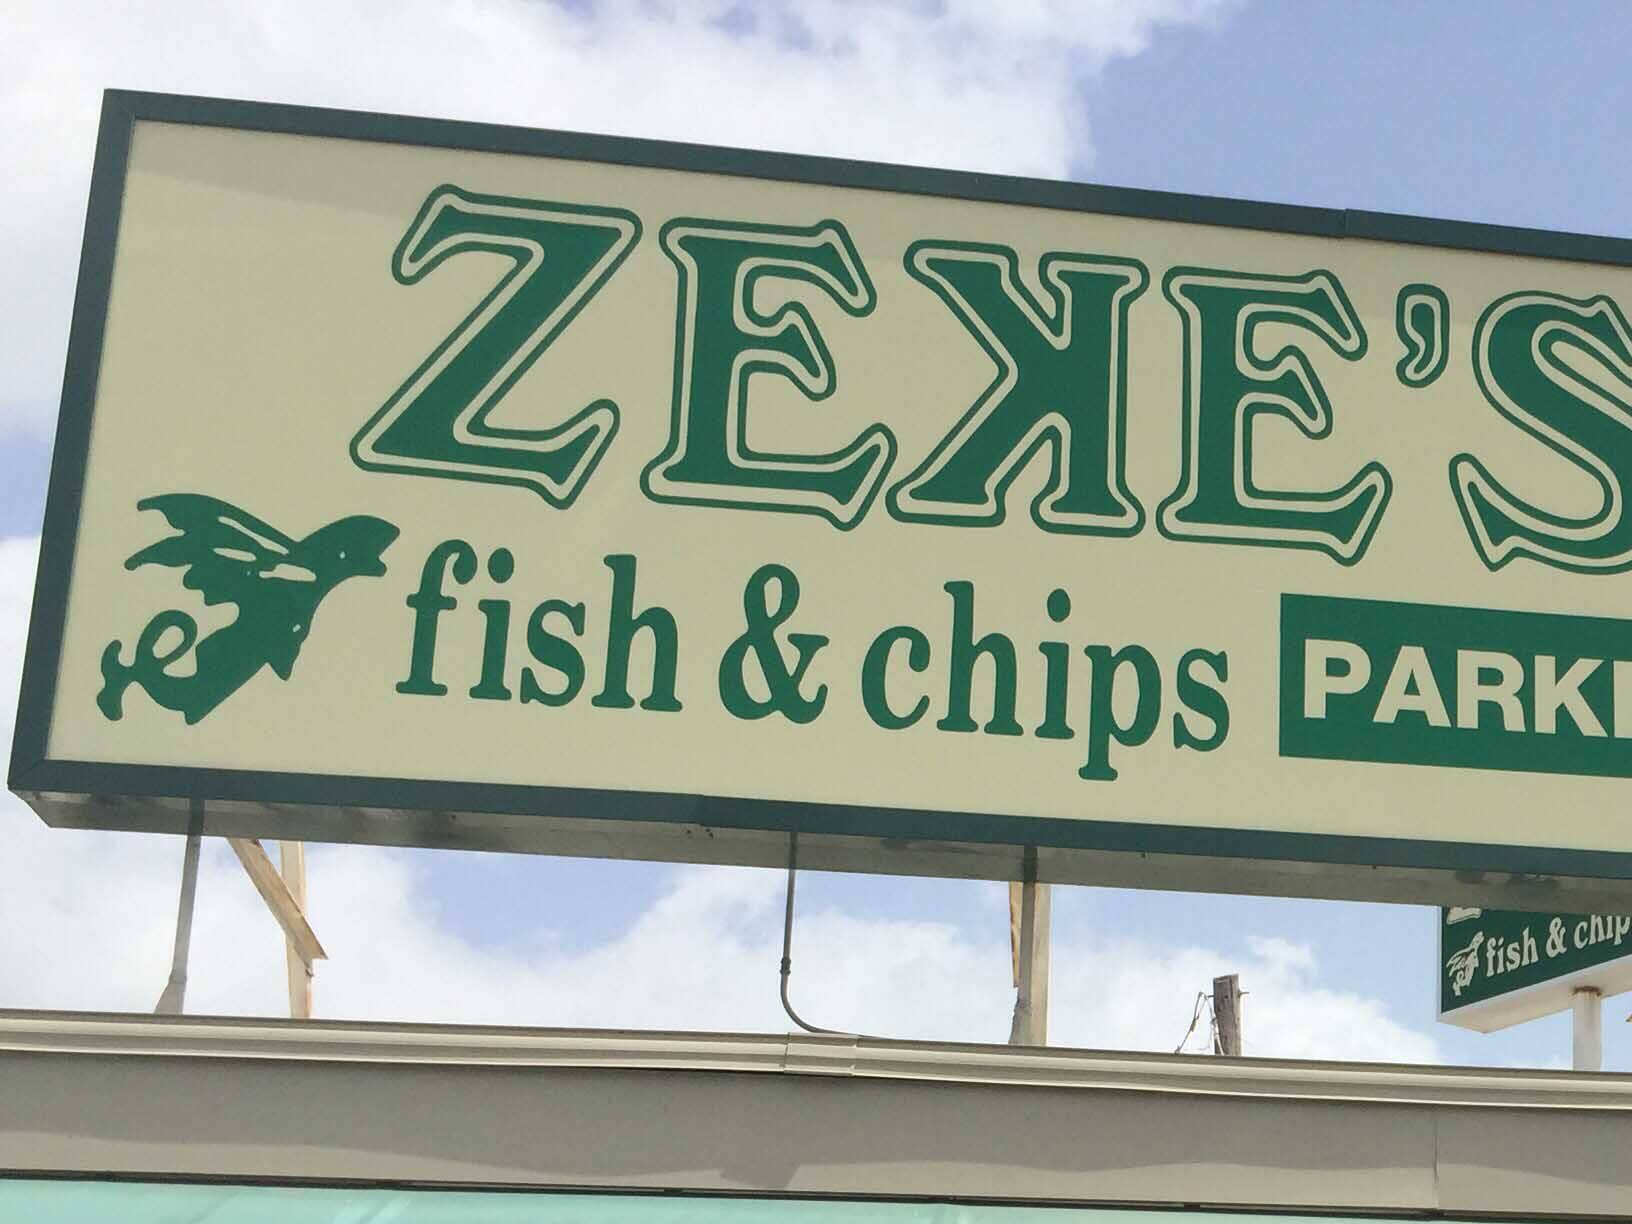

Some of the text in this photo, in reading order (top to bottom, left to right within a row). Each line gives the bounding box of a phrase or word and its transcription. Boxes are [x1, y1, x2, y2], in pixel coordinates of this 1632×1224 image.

[396, 539, 1231, 781] fish & chips
[1485, 927, 1539, 978] fish
[1545, 916, 1567, 958] &
